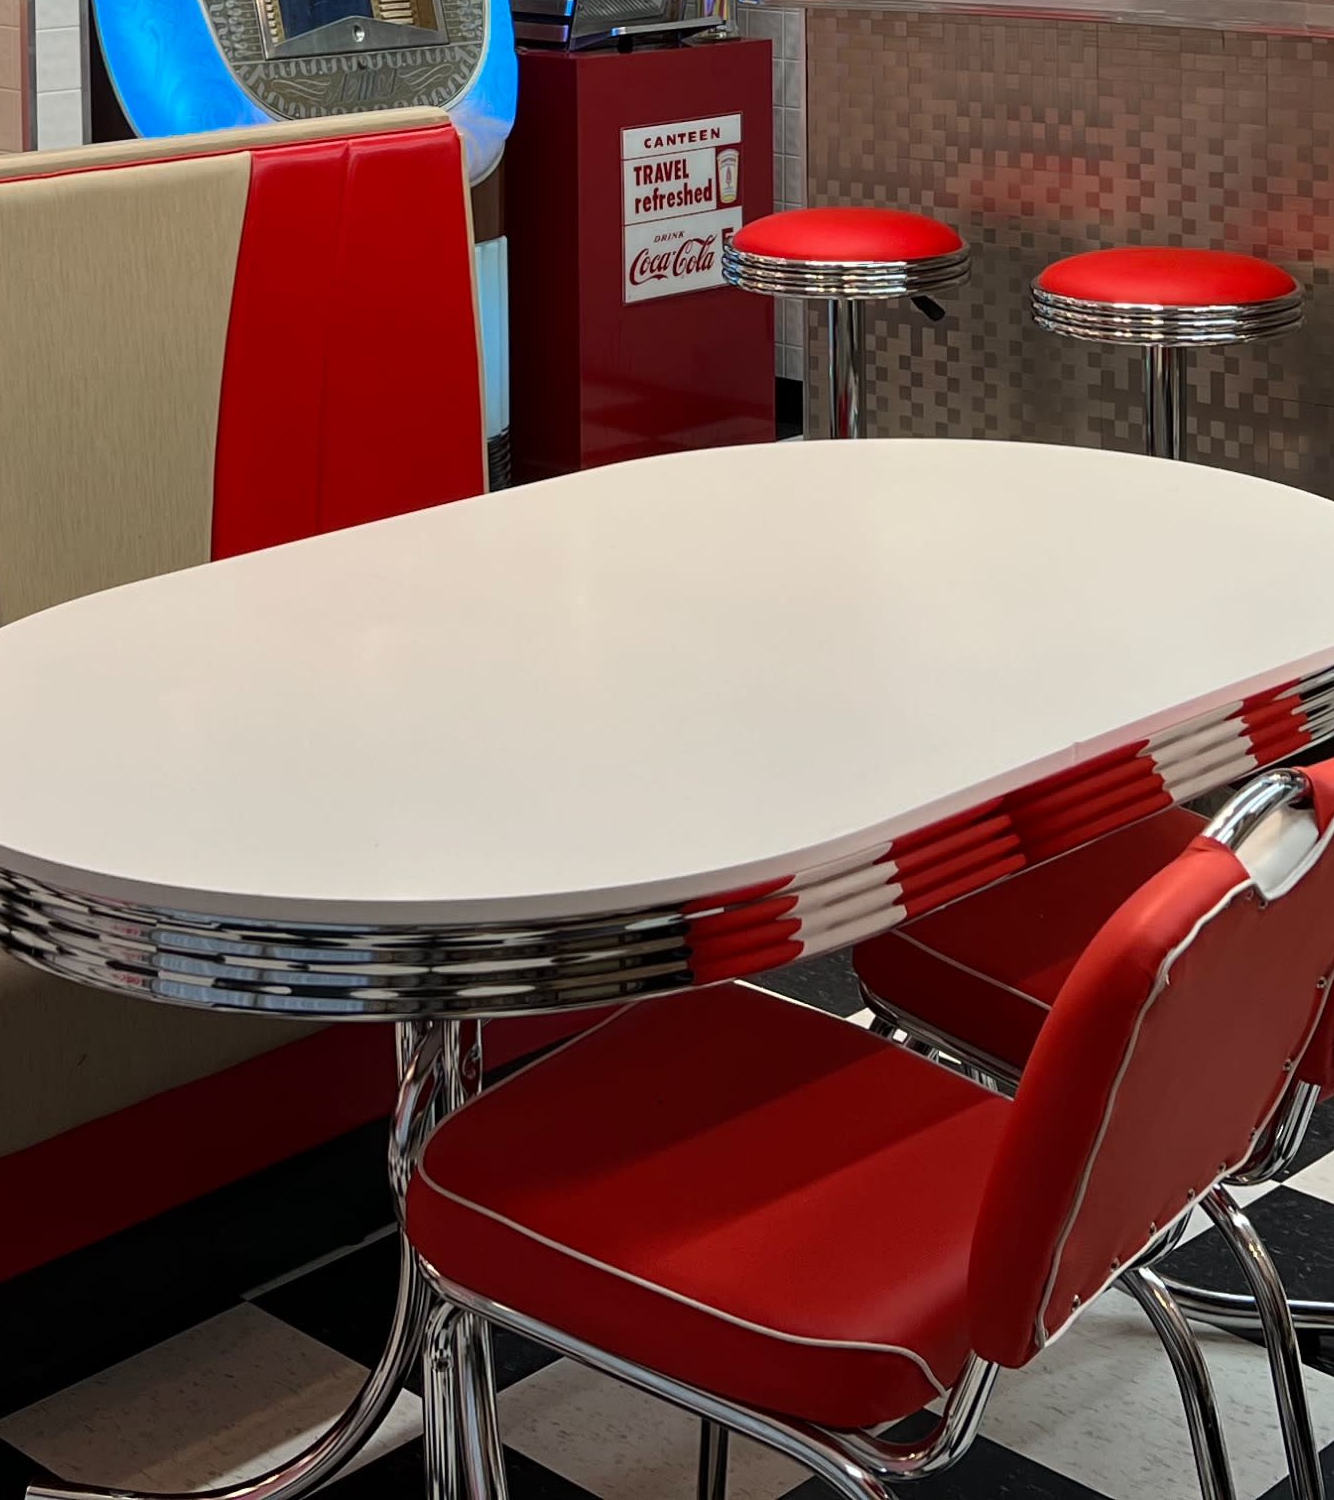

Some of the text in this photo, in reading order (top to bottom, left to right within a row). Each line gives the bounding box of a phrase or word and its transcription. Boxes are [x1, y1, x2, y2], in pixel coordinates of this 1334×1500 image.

[644, 127, 721, 149] CANTEEN
[633, 158, 690, 187] TRAVEL
[634, 178, 713, 214] refreshed
[653, 230, 686, 243] DRINK
[629, 235, 717, 286] Coca-Cola
